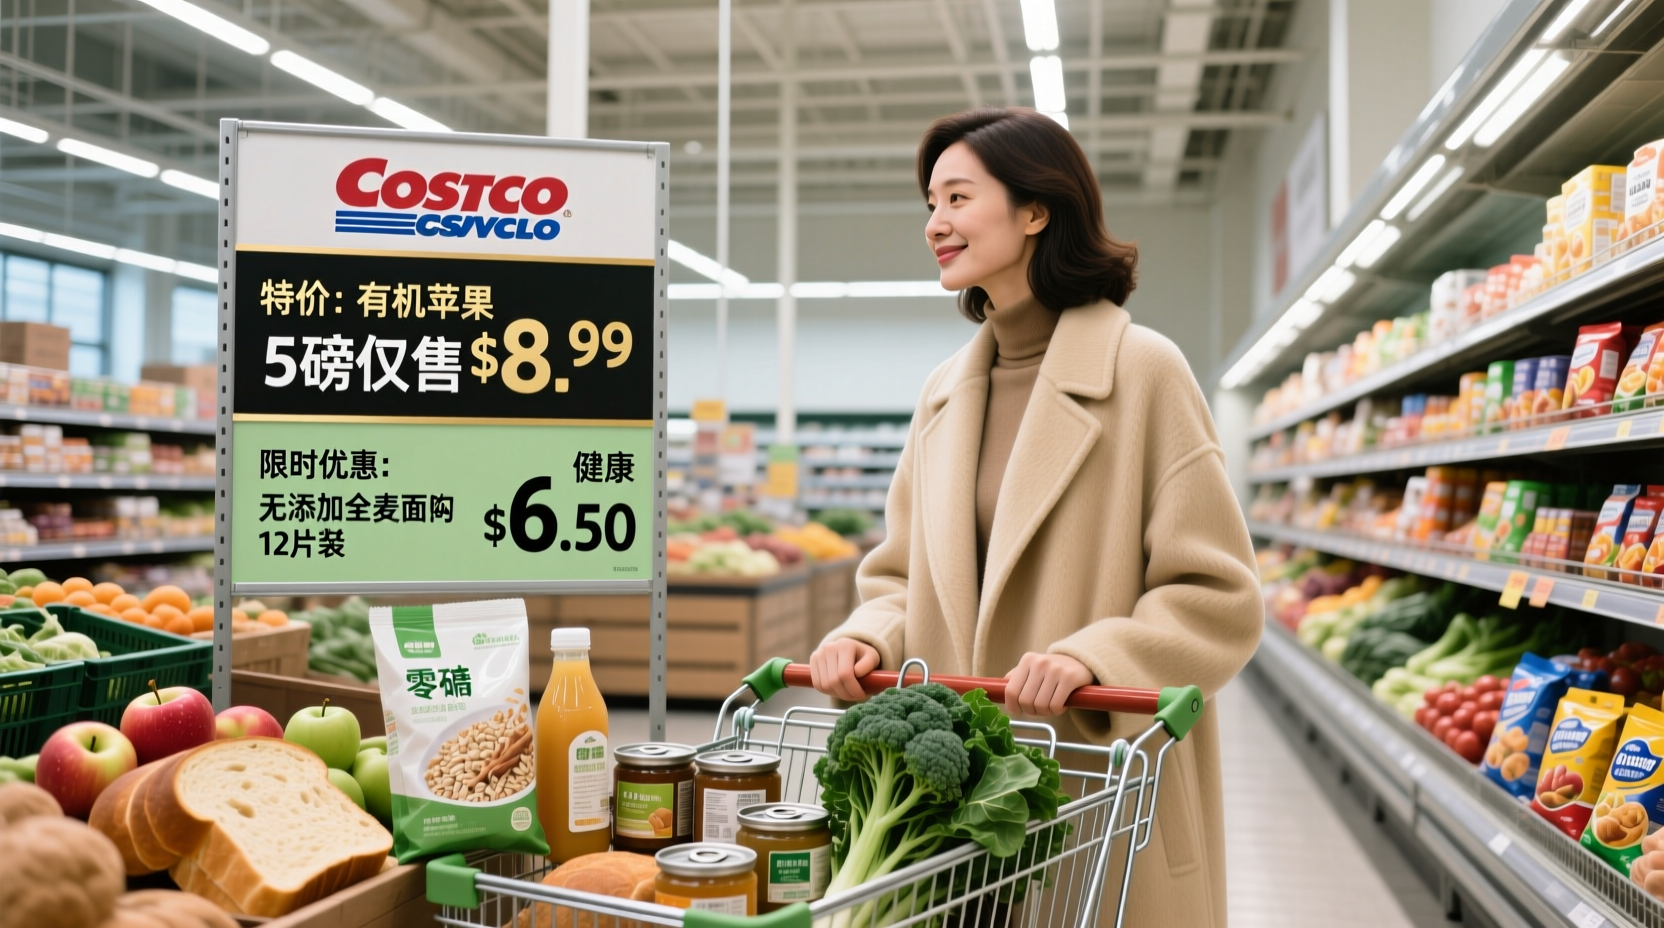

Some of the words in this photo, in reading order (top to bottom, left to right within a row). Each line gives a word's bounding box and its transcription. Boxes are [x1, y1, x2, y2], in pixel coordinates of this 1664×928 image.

[336, 158, 568, 215] COSTCO
[264, 333, 462, 394] 5磅仅售
[470, 317, 633, 394] $8.99
[259, 448, 390, 480] 限时优惠：
[573, 450, 635, 484] 健康
[483, 475, 637, 552] $6.50
[258, 527, 346, 559] 12片装
